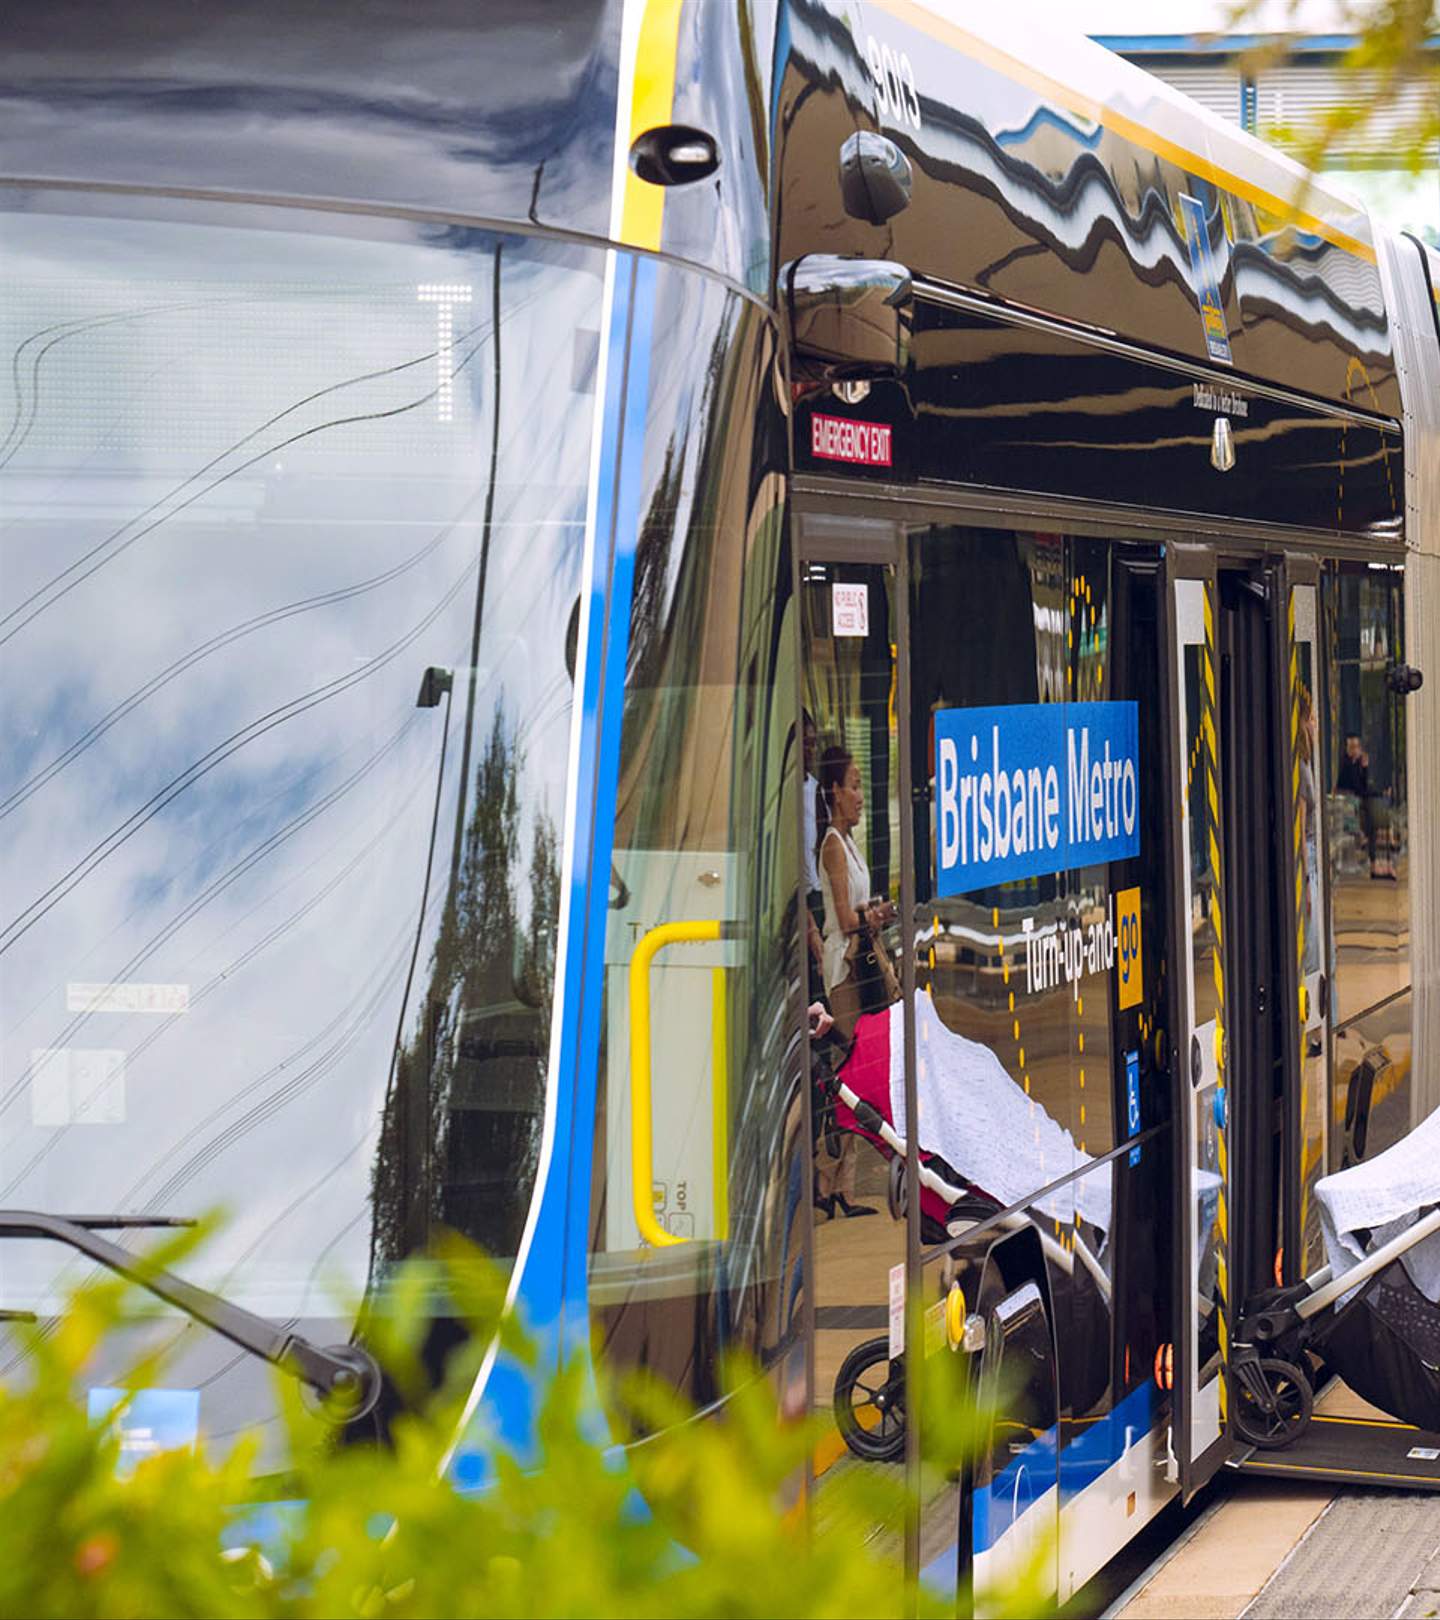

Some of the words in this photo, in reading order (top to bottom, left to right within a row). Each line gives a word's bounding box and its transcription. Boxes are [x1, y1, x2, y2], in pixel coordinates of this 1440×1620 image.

[867, 35, 921, 131] 9013
[813, 416, 870, 464] EMERGENCY
[871, 426, 891, 462] EXIT
[940, 725, 1060, 870] Brisbane
[1067, 727, 1136, 844] Metro
